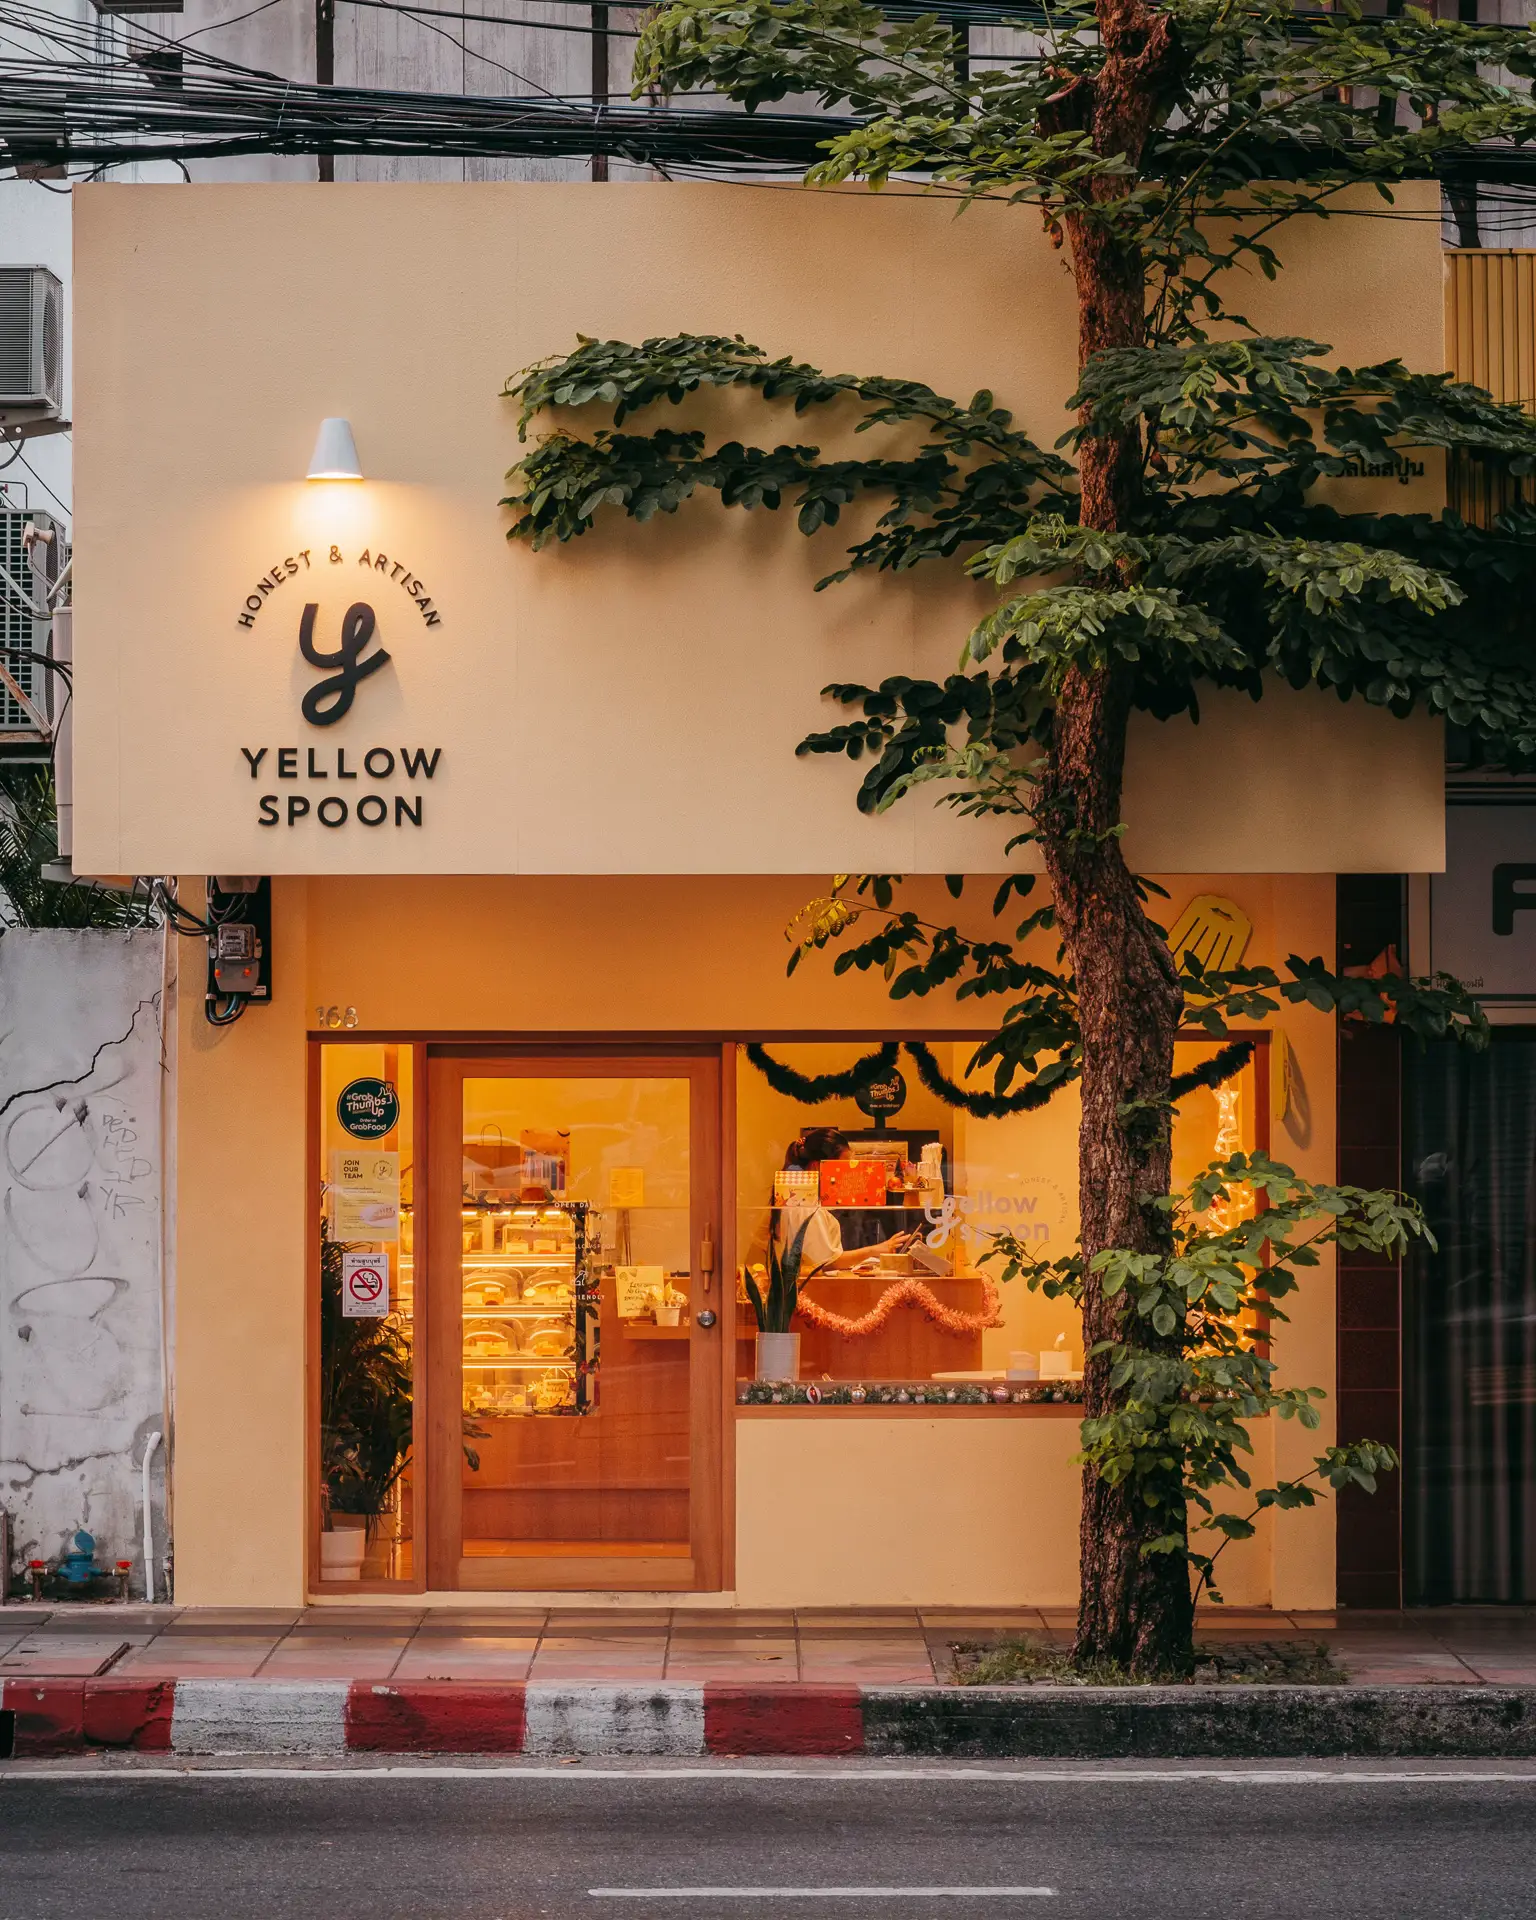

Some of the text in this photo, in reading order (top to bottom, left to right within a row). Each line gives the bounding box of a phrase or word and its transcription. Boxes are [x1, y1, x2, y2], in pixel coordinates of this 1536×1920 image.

[237, 545, 441, 629] HONEST & ARTISAN
[240, 747, 443, 779] YELLOW
[257, 795, 423, 828] SPOON
[315, 1005, 359, 1029] 168
[346, 1096, 387, 1112] Thumbs
[371, 1104, 385, 1117] Up
[349, 1123, 387, 1131] GrabFood
